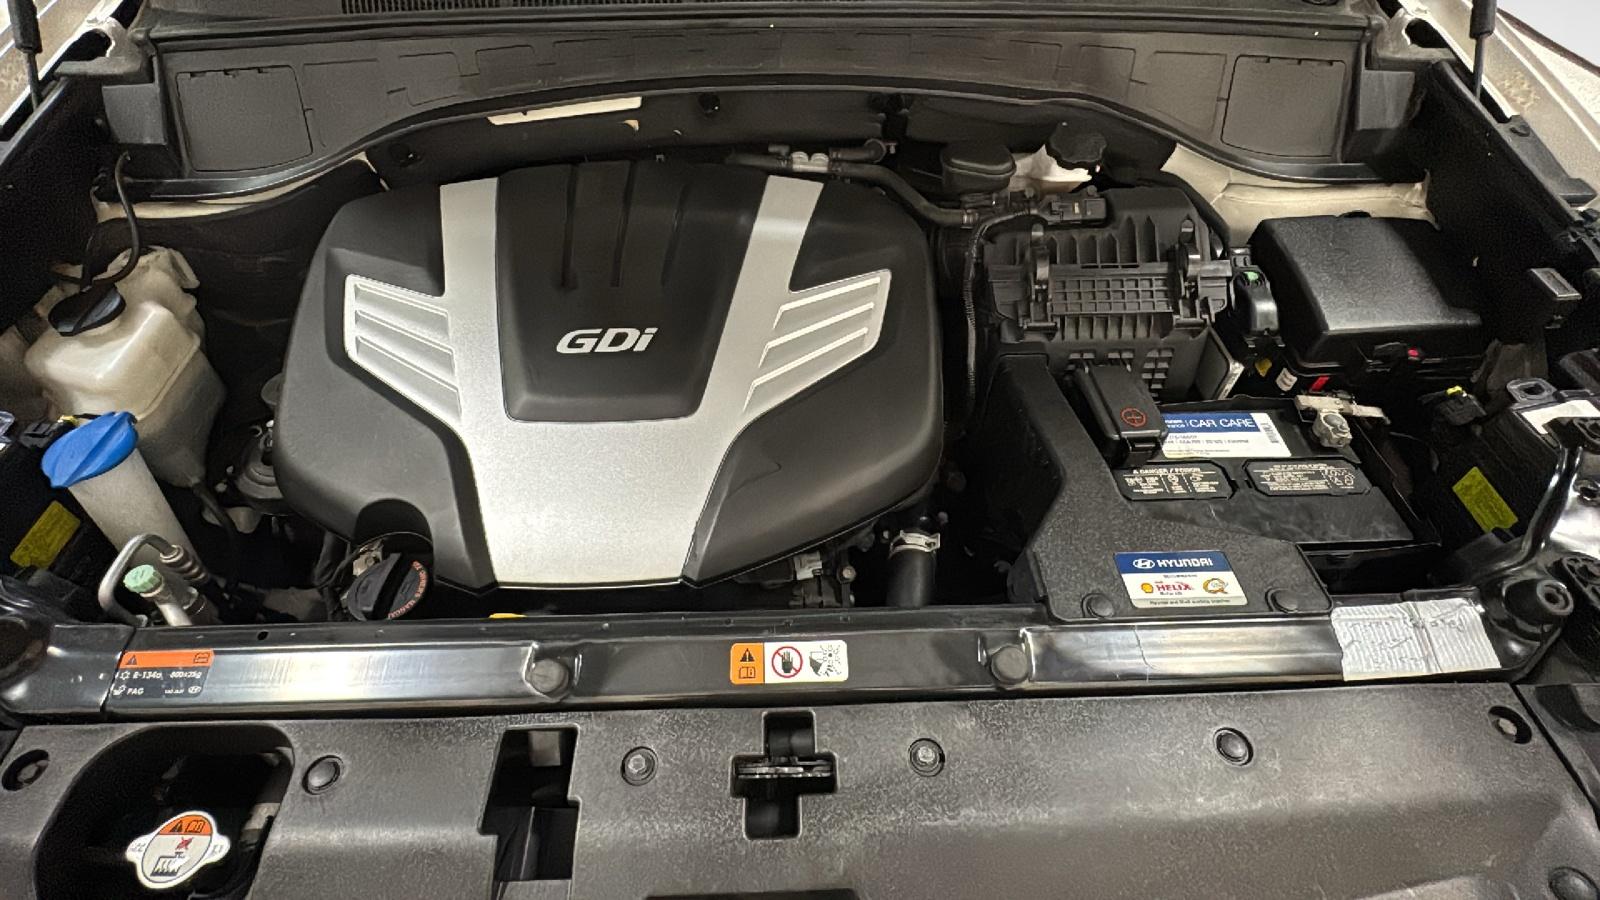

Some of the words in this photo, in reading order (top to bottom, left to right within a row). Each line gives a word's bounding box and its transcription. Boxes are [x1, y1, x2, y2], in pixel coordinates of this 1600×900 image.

[556, 327, 659, 354] GDi
[1189, 419, 1218, 428] CAR
[1219, 418, 1257, 428] CARE
[1156, 557, 1214, 567] HYUNDAI
[1156, 584, 1192, 592] HELIX
[126, 686, 145, 696] PAG
